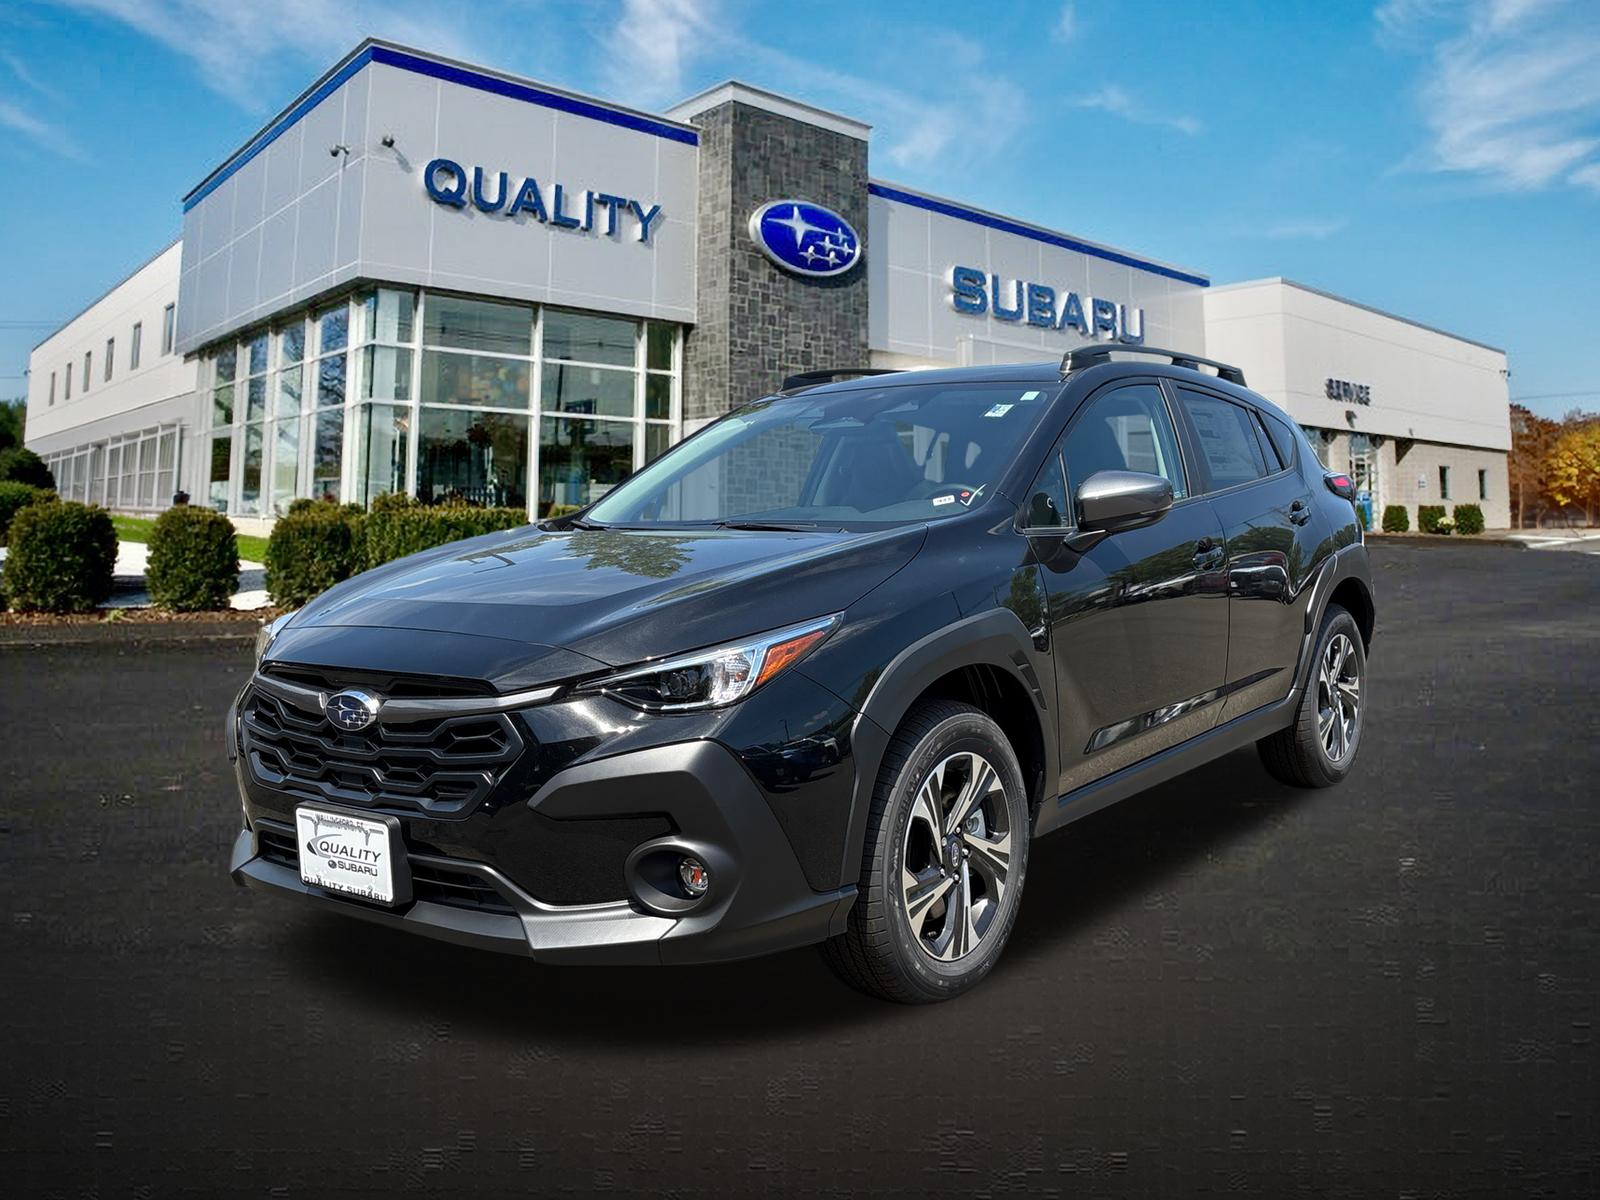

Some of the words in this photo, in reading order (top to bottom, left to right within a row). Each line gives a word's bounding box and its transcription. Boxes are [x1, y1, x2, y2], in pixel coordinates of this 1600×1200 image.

[424, 158, 661, 243] QUALITY
[948, 265, 1145, 345] SUBARU
[1324, 377, 1371, 407] SERVICE
[319, 841, 381, 862] QUALITY
[337, 861, 378, 877] SUBARU
[303, 876, 344, 891] QUALITY
[346, 886, 388, 901] SUBARU
